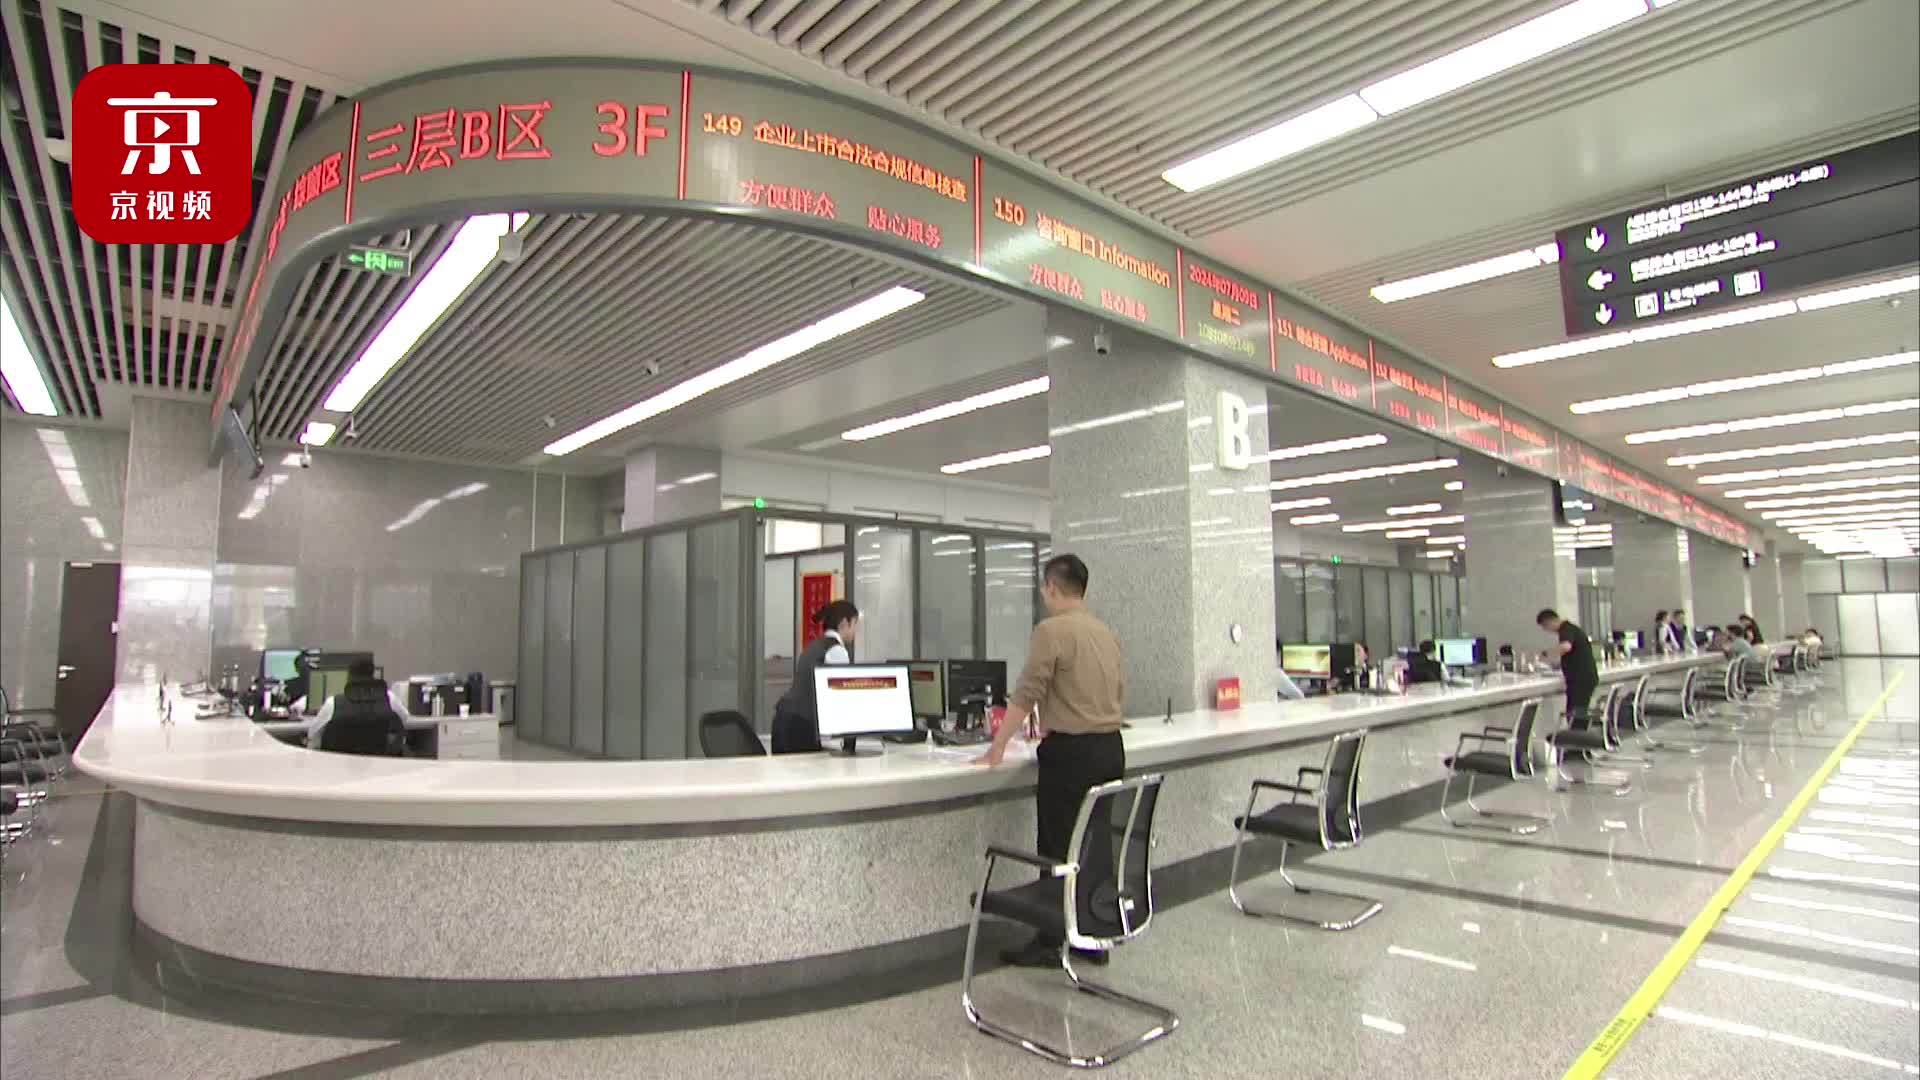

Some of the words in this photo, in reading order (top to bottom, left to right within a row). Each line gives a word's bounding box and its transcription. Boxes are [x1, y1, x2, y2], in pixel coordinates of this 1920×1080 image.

[360, 101, 553, 182] 三层B区
[592, 101, 671, 157] 3F
[703, 112, 743, 136] 149
[740, 180, 837, 220] 方便群众
[867, 205, 942, 249] 贴心服务
[994, 197, 1025, 226] 150
[1099, 240, 1171, 288] Information
[1217, 391, 1251, 470] B
